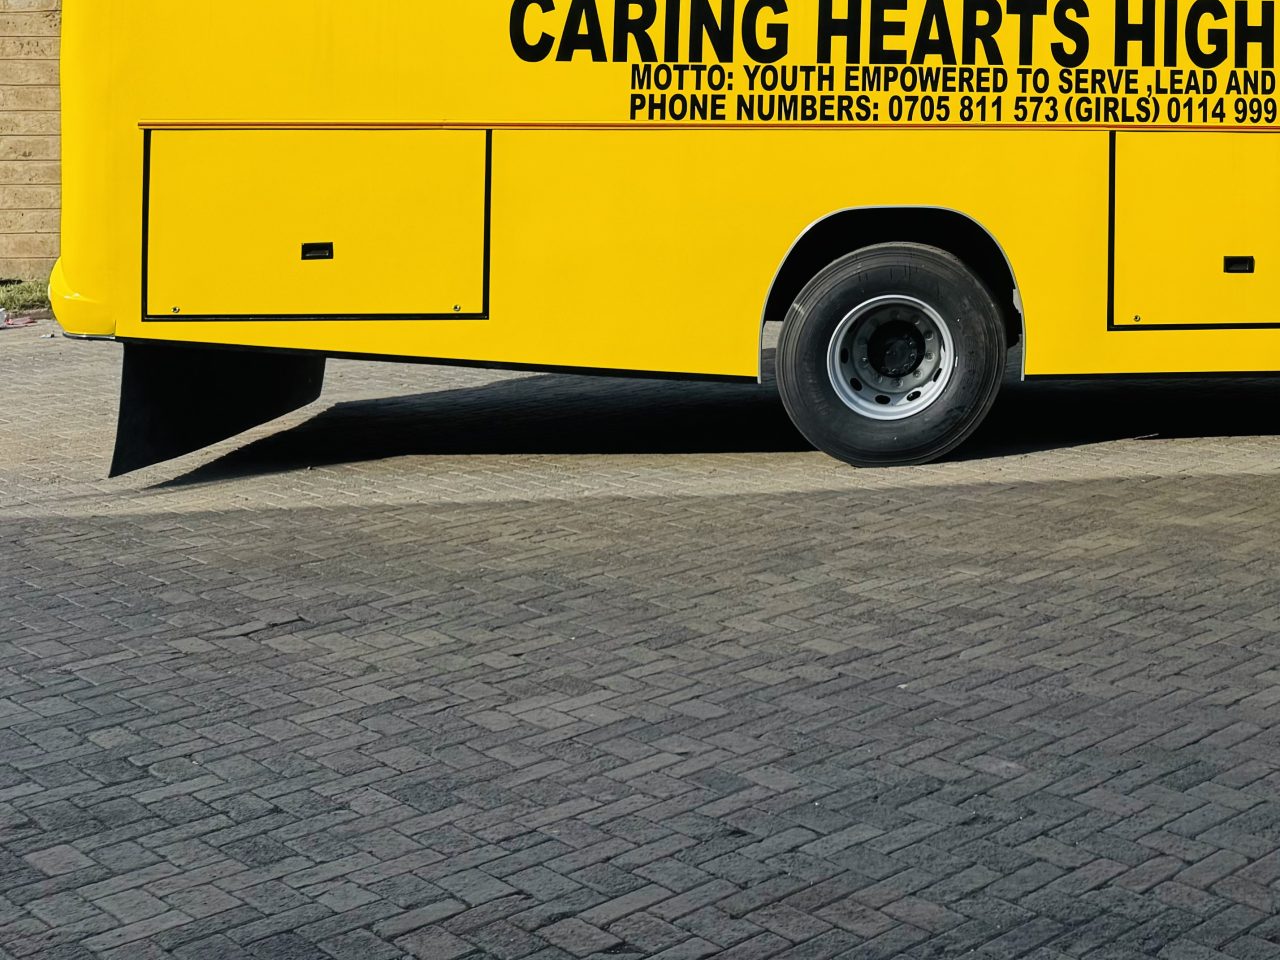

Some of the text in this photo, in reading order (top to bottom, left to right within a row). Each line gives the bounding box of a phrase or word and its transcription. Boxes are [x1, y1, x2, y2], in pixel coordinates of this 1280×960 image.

[631, 63, 734, 91] MOTTO:
[743, 64, 835, 92] YOUTH
[844, 65, 1008, 93] EMPOWERED
[1017, 67, 1050, 94] TO
[1058, 68, 1139, 95] SERVE
[1226, 69, 1276, 95] AND
[630, 93, 726, 121] PHONE
[737, 94, 879, 122] NUMBERS:
[888, 95, 951, 122] 0705
[960, 96, 1002, 122] 811
[1168, 97, 1226, 123] 0114
[1235, 97, 1277, 124] 999
